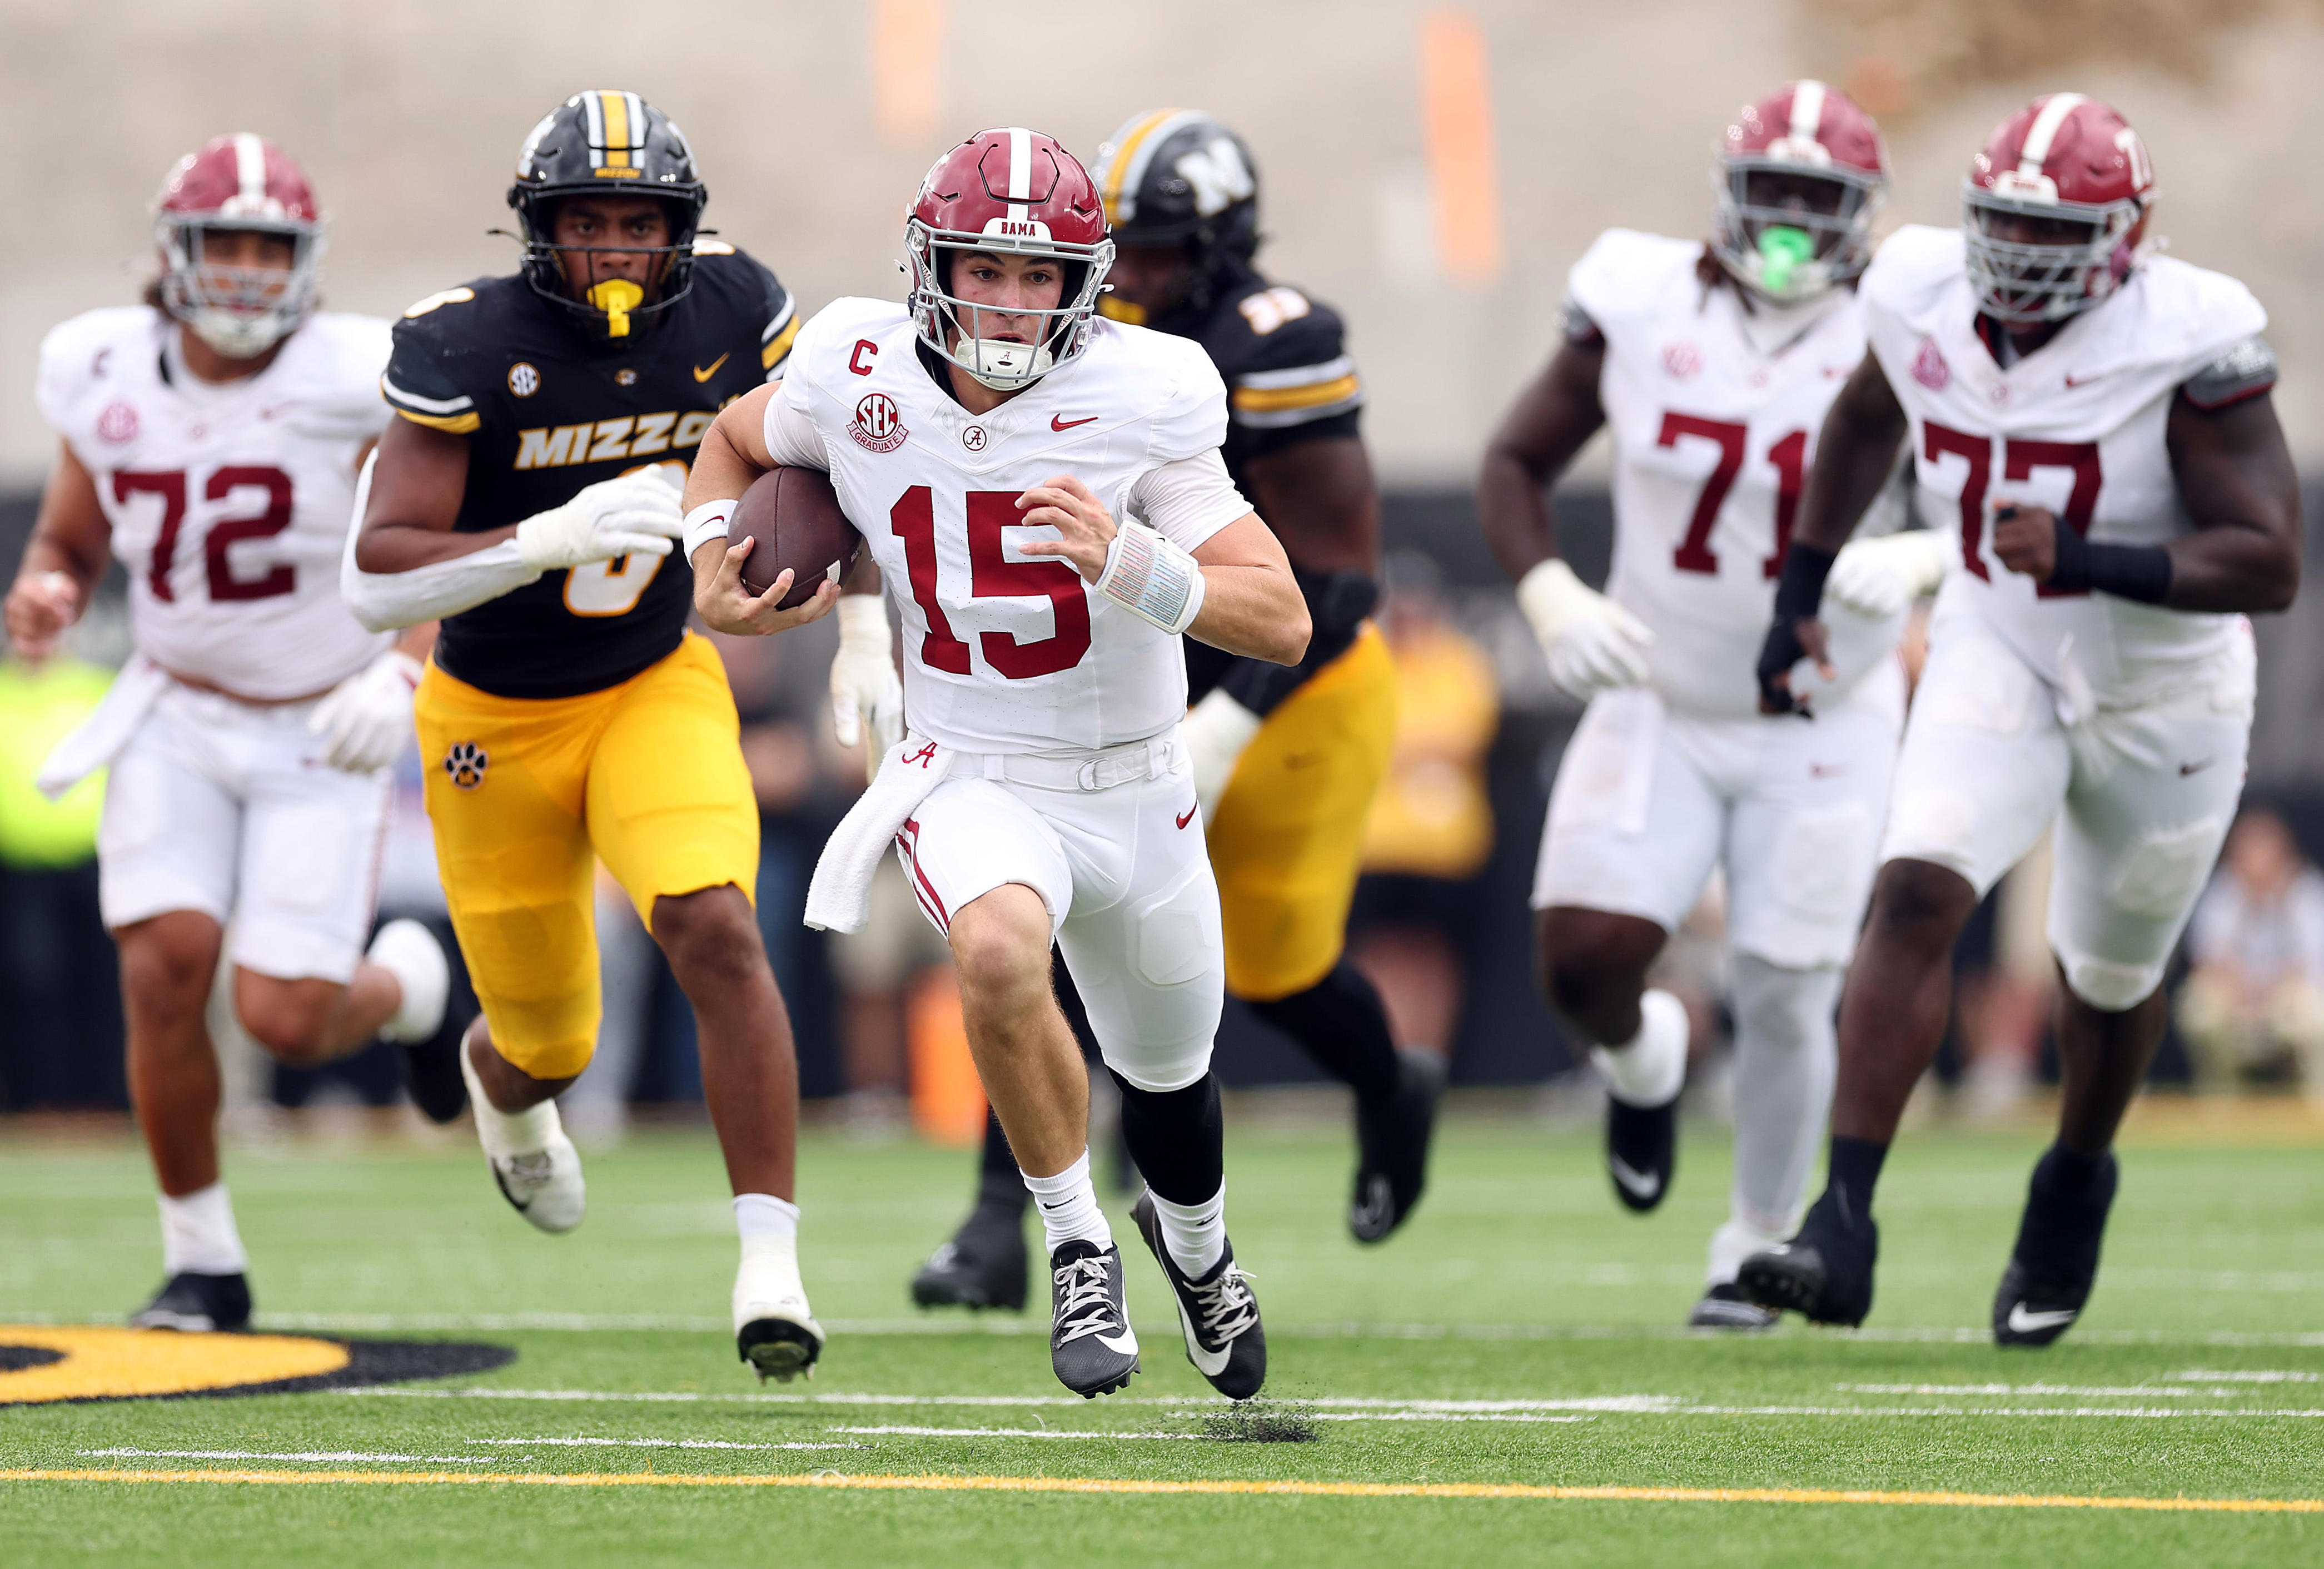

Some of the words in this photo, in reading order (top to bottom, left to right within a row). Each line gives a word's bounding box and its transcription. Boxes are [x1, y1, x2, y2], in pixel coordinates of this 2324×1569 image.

[1001, 222, 1036, 236] BAMA
[849, 339, 878, 376] C
[858, 395, 896, 437] SEC
[966, 429, 982, 445] A
[512, 410, 721, 470] MIZZO
[854, 432, 900, 451] GRADUATE
[1656, 411, 1808, 581] 71
[1923, 419, 2104, 600] 77
[112, 465, 297, 604] 72
[889, 485, 1092, 679] 15
[902, 742, 938, 769] A
